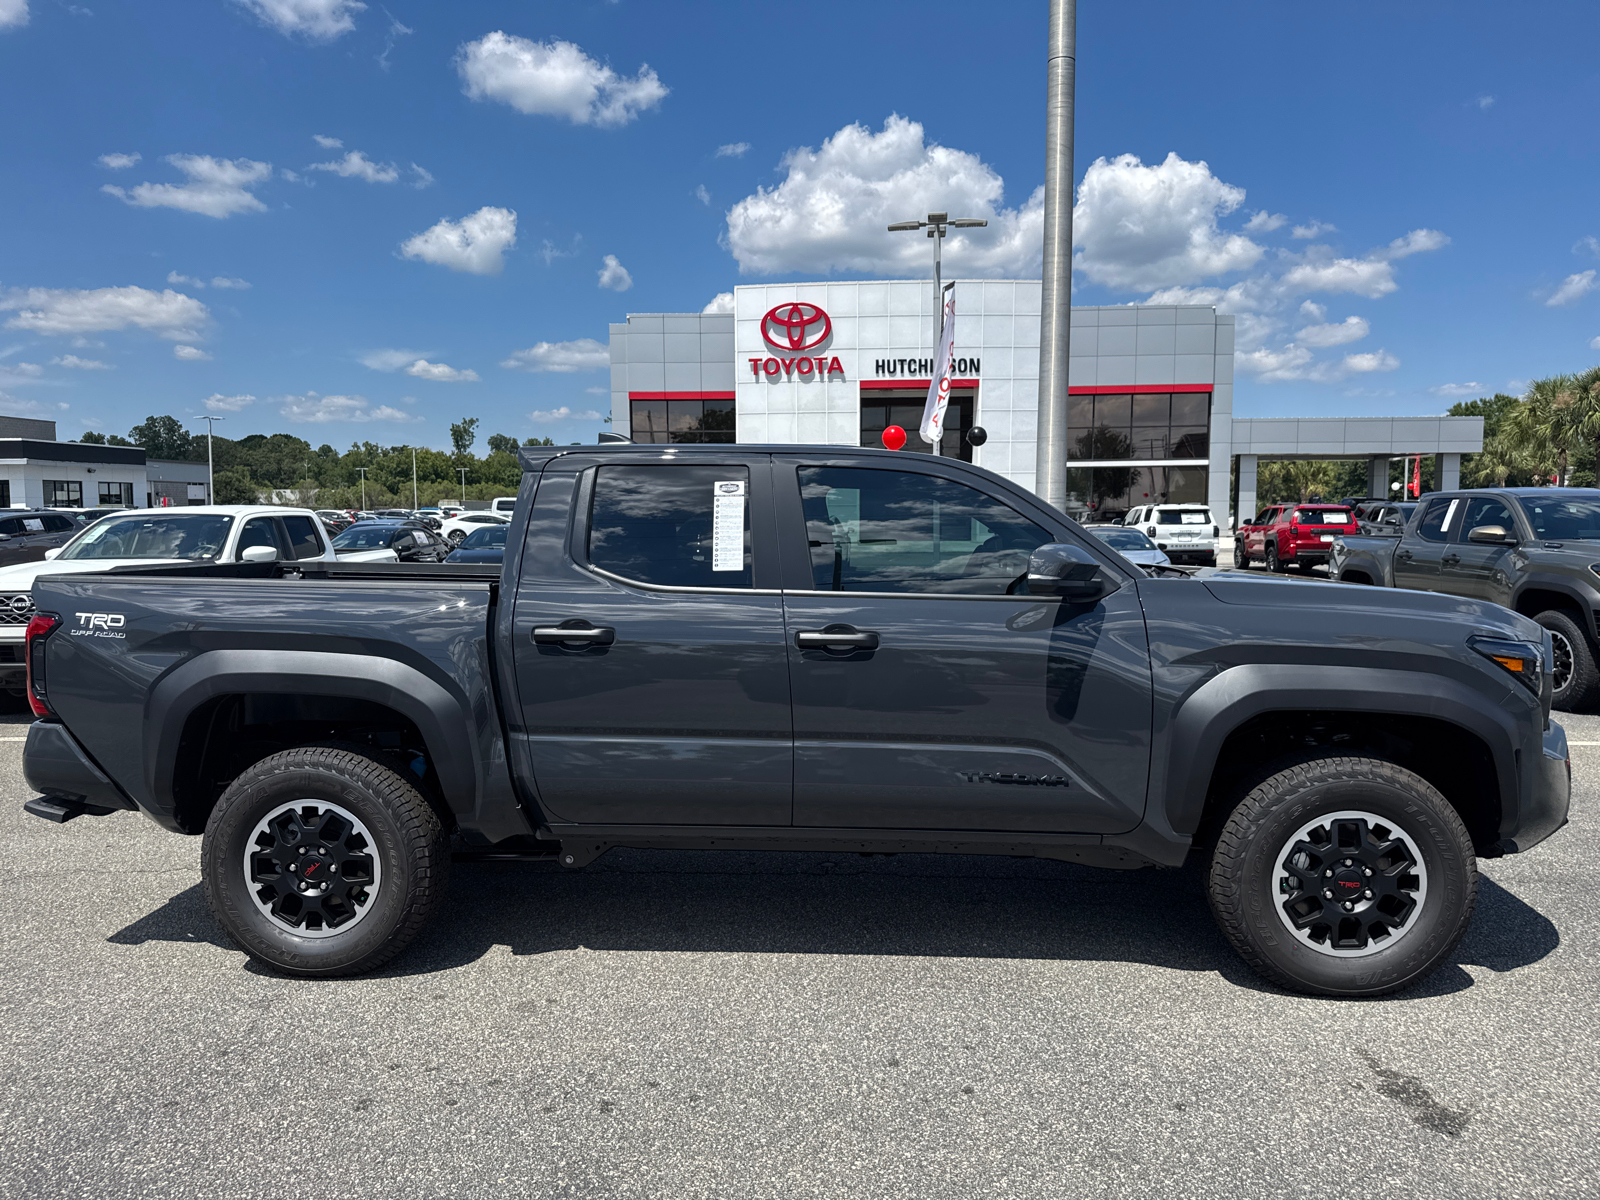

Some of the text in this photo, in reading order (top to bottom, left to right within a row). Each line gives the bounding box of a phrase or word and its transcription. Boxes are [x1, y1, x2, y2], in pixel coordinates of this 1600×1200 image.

[748, 356, 844, 376] TOYOTA
[875, 358, 980, 374] HUTCHISON
[75, 612, 125, 630] TRD
[1337, 880, 1361, 889] TRD
